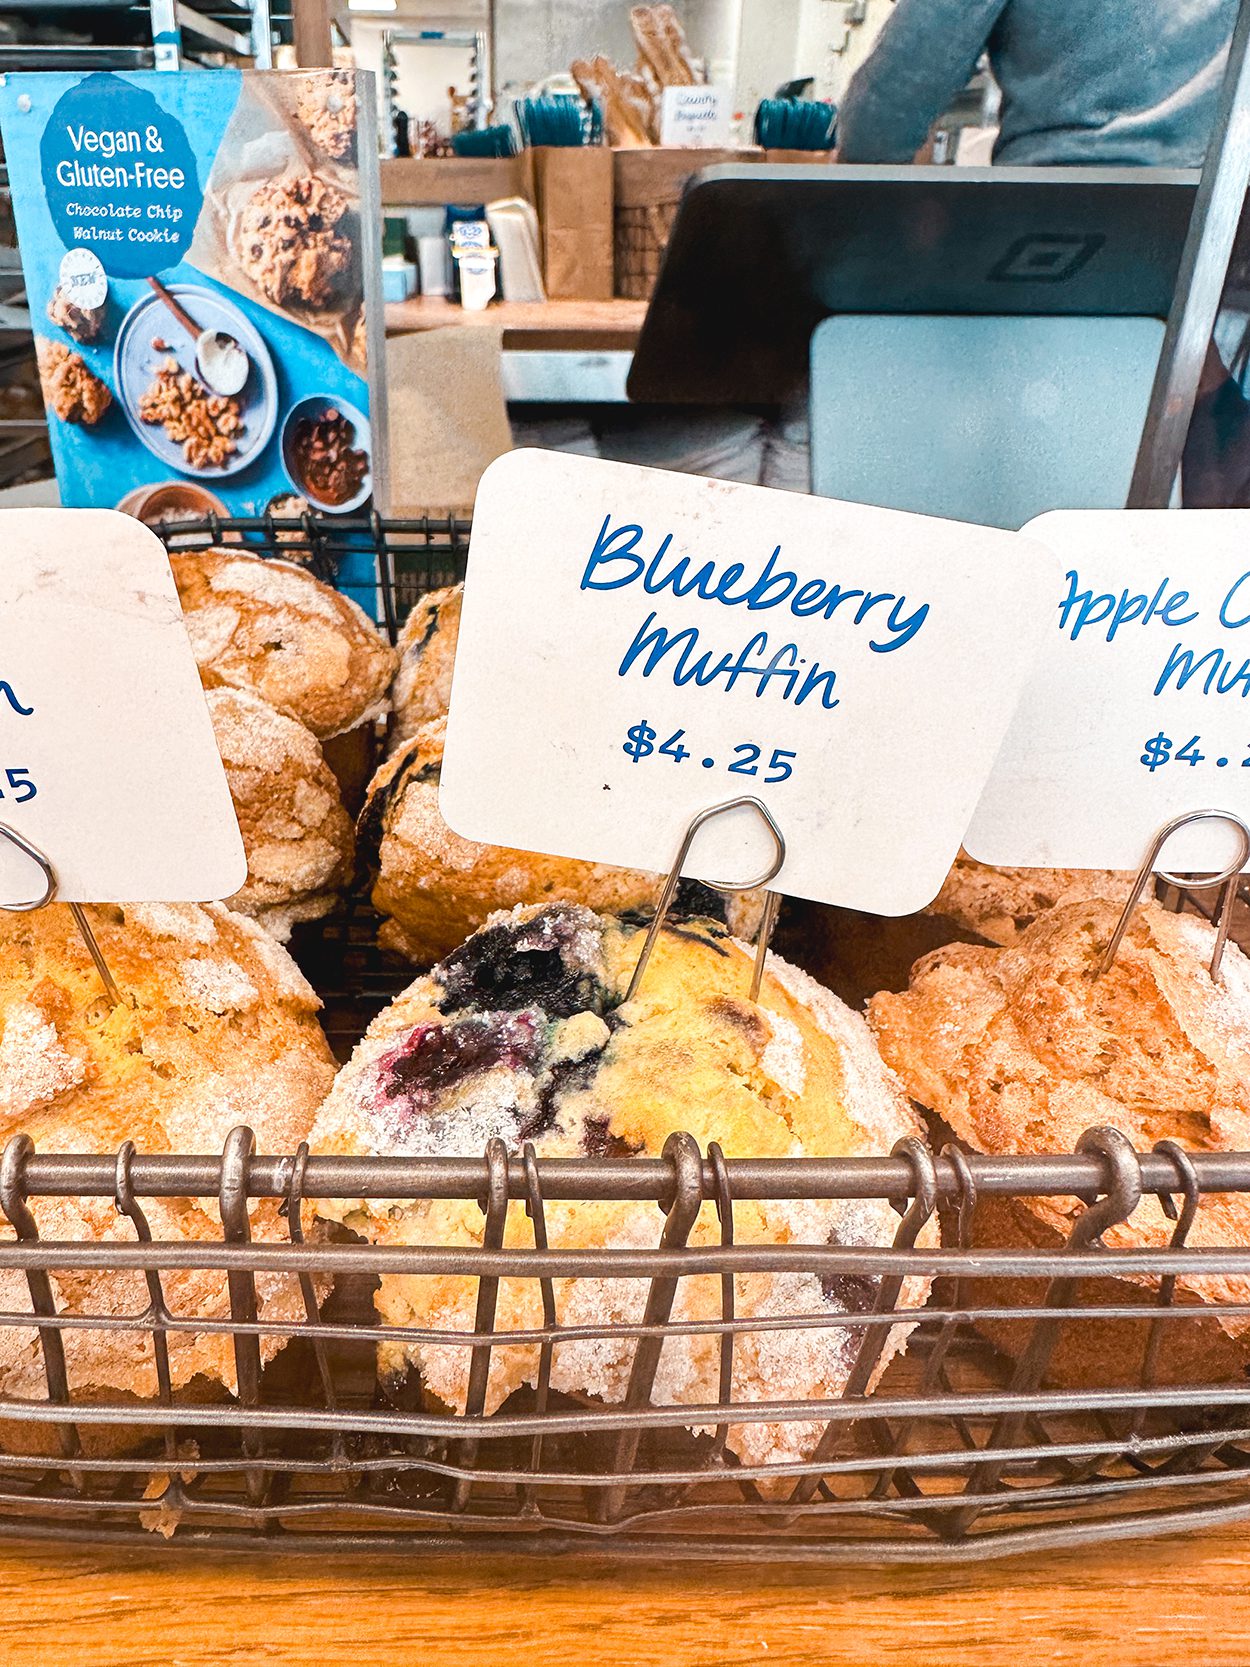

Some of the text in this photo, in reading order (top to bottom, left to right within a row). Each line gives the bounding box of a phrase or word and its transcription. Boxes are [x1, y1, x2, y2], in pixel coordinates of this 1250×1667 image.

[66, 125, 165, 158] Vegan &
[56, 160, 185, 189] Gluten-Free
[66, 202, 183, 222] Chocolate Chip
[73, 226, 180, 243] Walnut Cookie
[579, 514, 931, 653] Blueberry
[618, 610, 840, 709] Muffin
[622, 720, 797, 784] $4.25
